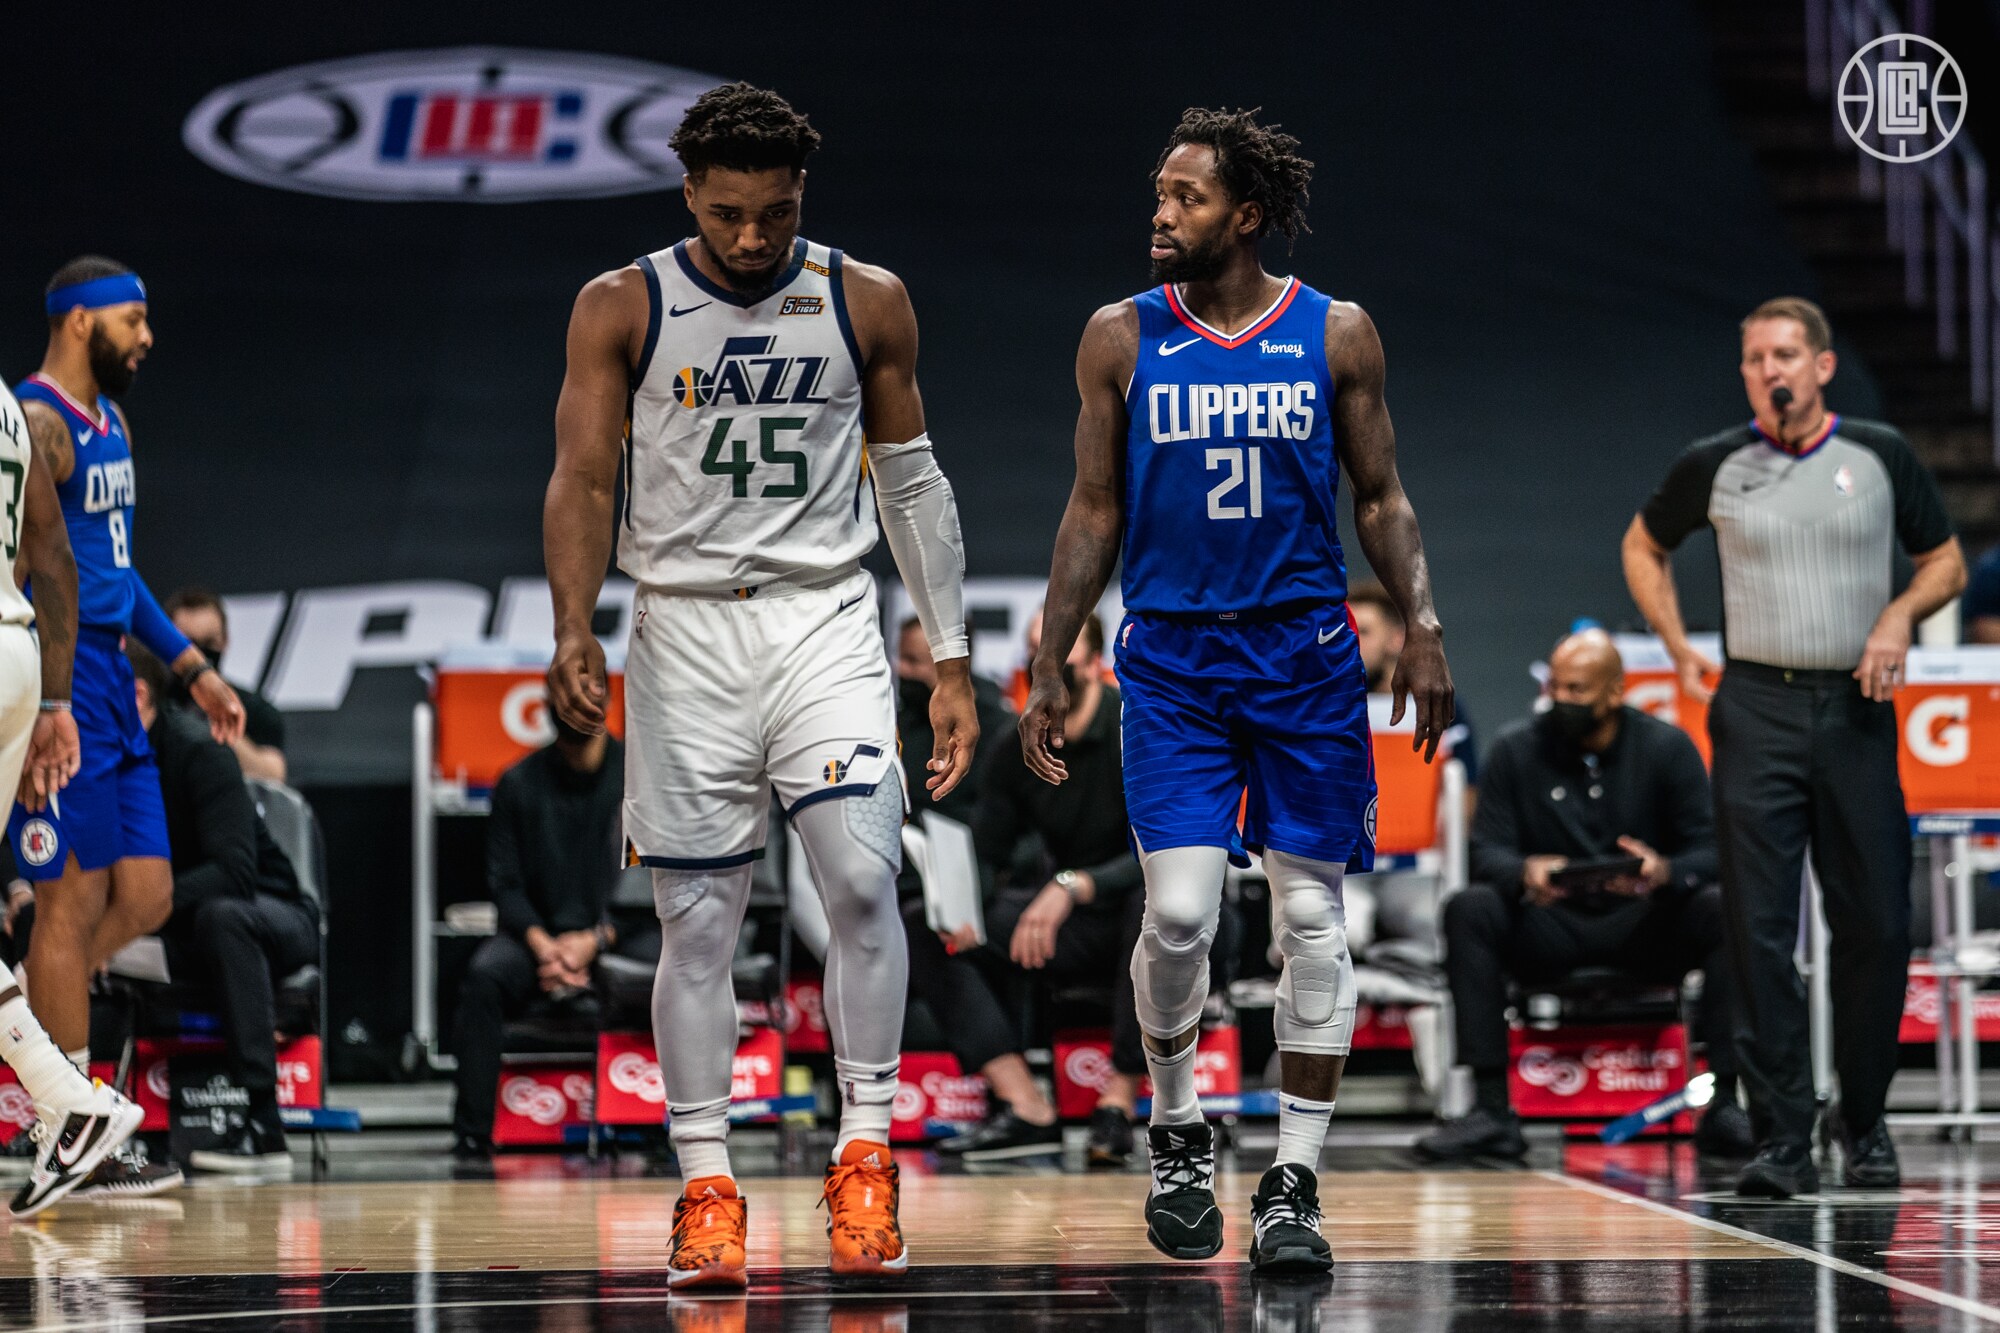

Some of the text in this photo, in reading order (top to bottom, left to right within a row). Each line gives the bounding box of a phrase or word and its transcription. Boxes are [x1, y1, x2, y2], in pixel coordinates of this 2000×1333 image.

[803, 260, 830, 277] 1223
[782, 298, 796, 315] 5
[795, 305, 821, 314] FIGHT
[672, 335, 830, 409] JAZZ
[1258, 339, 1305, 359] honey
[1148, 381, 1316, 444] CLIPPERS
[700, 417, 809, 498] 45
[1205, 446, 1263, 520] 21
[108, 509, 131, 569] 8
[1905, 695, 1970, 767] G
